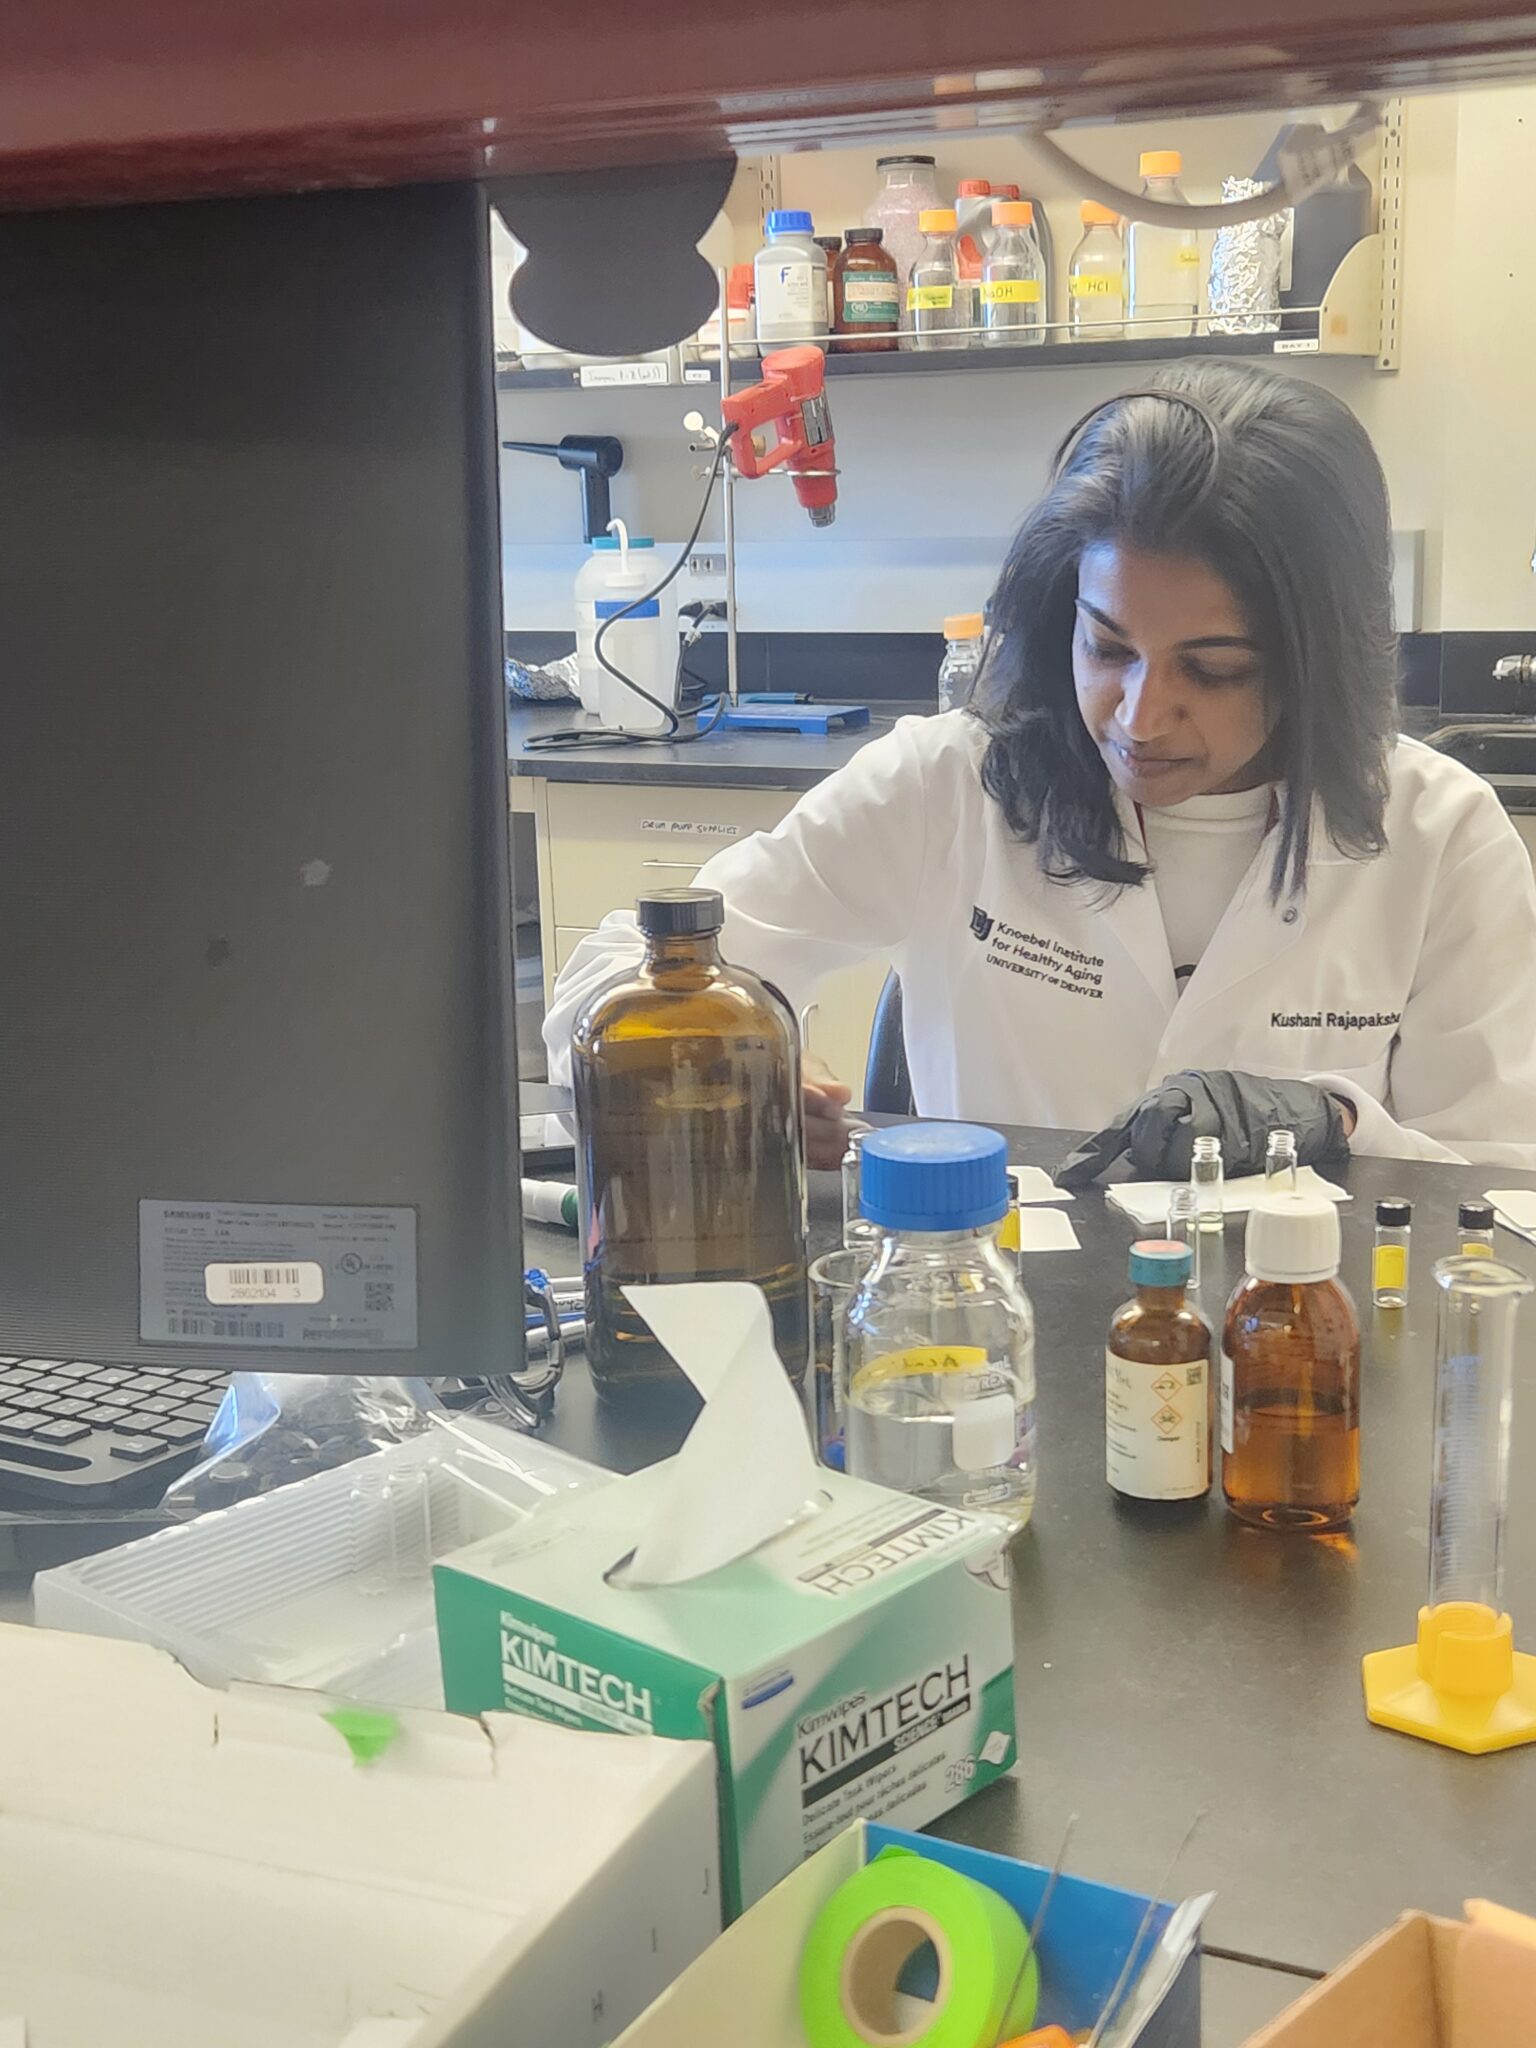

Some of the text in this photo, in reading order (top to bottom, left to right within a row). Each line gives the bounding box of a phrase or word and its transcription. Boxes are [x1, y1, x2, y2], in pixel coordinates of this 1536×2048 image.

[992, 937, 1104, 986] for Healthy Aging
[996, 921, 1105, 967] Knoebel Institute
[986, 953, 1049, 982] UNIVERSITY
[1060, 979, 1104, 999] DENVER
[1271, 1011, 1323, 1027] Kushani
[813, 1511, 976, 1596] KIMTECH
[501, 1630, 652, 1721] KIMTECH
[797, 1689, 867, 1738] Kimwipes
[800, 1653, 970, 1784] KIMTECH
[865, 1764, 898, 1787] Wipers
